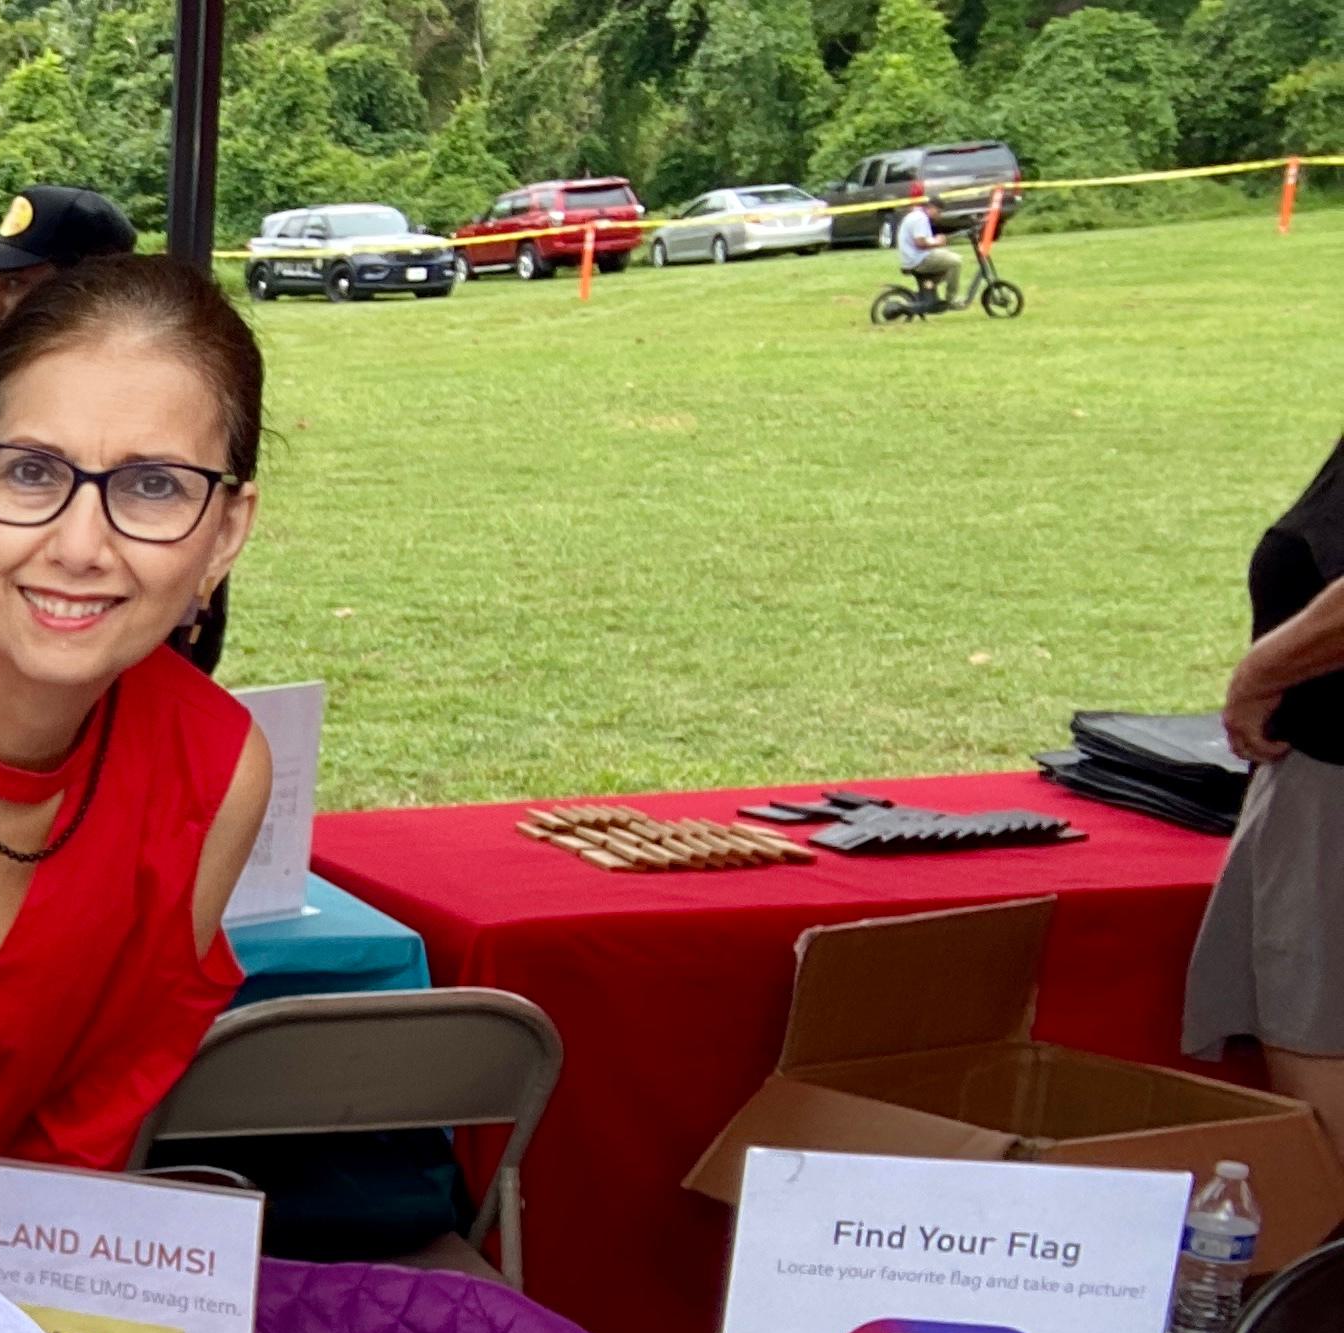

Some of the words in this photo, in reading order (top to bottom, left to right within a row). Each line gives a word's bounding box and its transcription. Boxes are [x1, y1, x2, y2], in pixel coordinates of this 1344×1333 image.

[90, 1234, 217, 1277] ALUMS!
[833, 1219, 907, 1251] Find
[919, 1224, 996, 1257] Your
[1008, 1231, 1082, 1267] Flag
[24, 1271, 35, 1285] a
[39, 1270, 87, 1294] FREE
[91, 1275, 137, 1301] UMD
[141, 1289, 189, 1314] swag
[193, 1293, 243, 1316] item.
[777, 1258, 834, 1278] Locate
[838, 1263, 877, 1282] your
[880, 1264, 946, 1286] favorite
[950, 1269, 983, 1292] flag
[986, 1273, 1019, 1291] and
[1023, 1276, 1061, 1294] take
[1063, 1281, 1075, 1295] a
